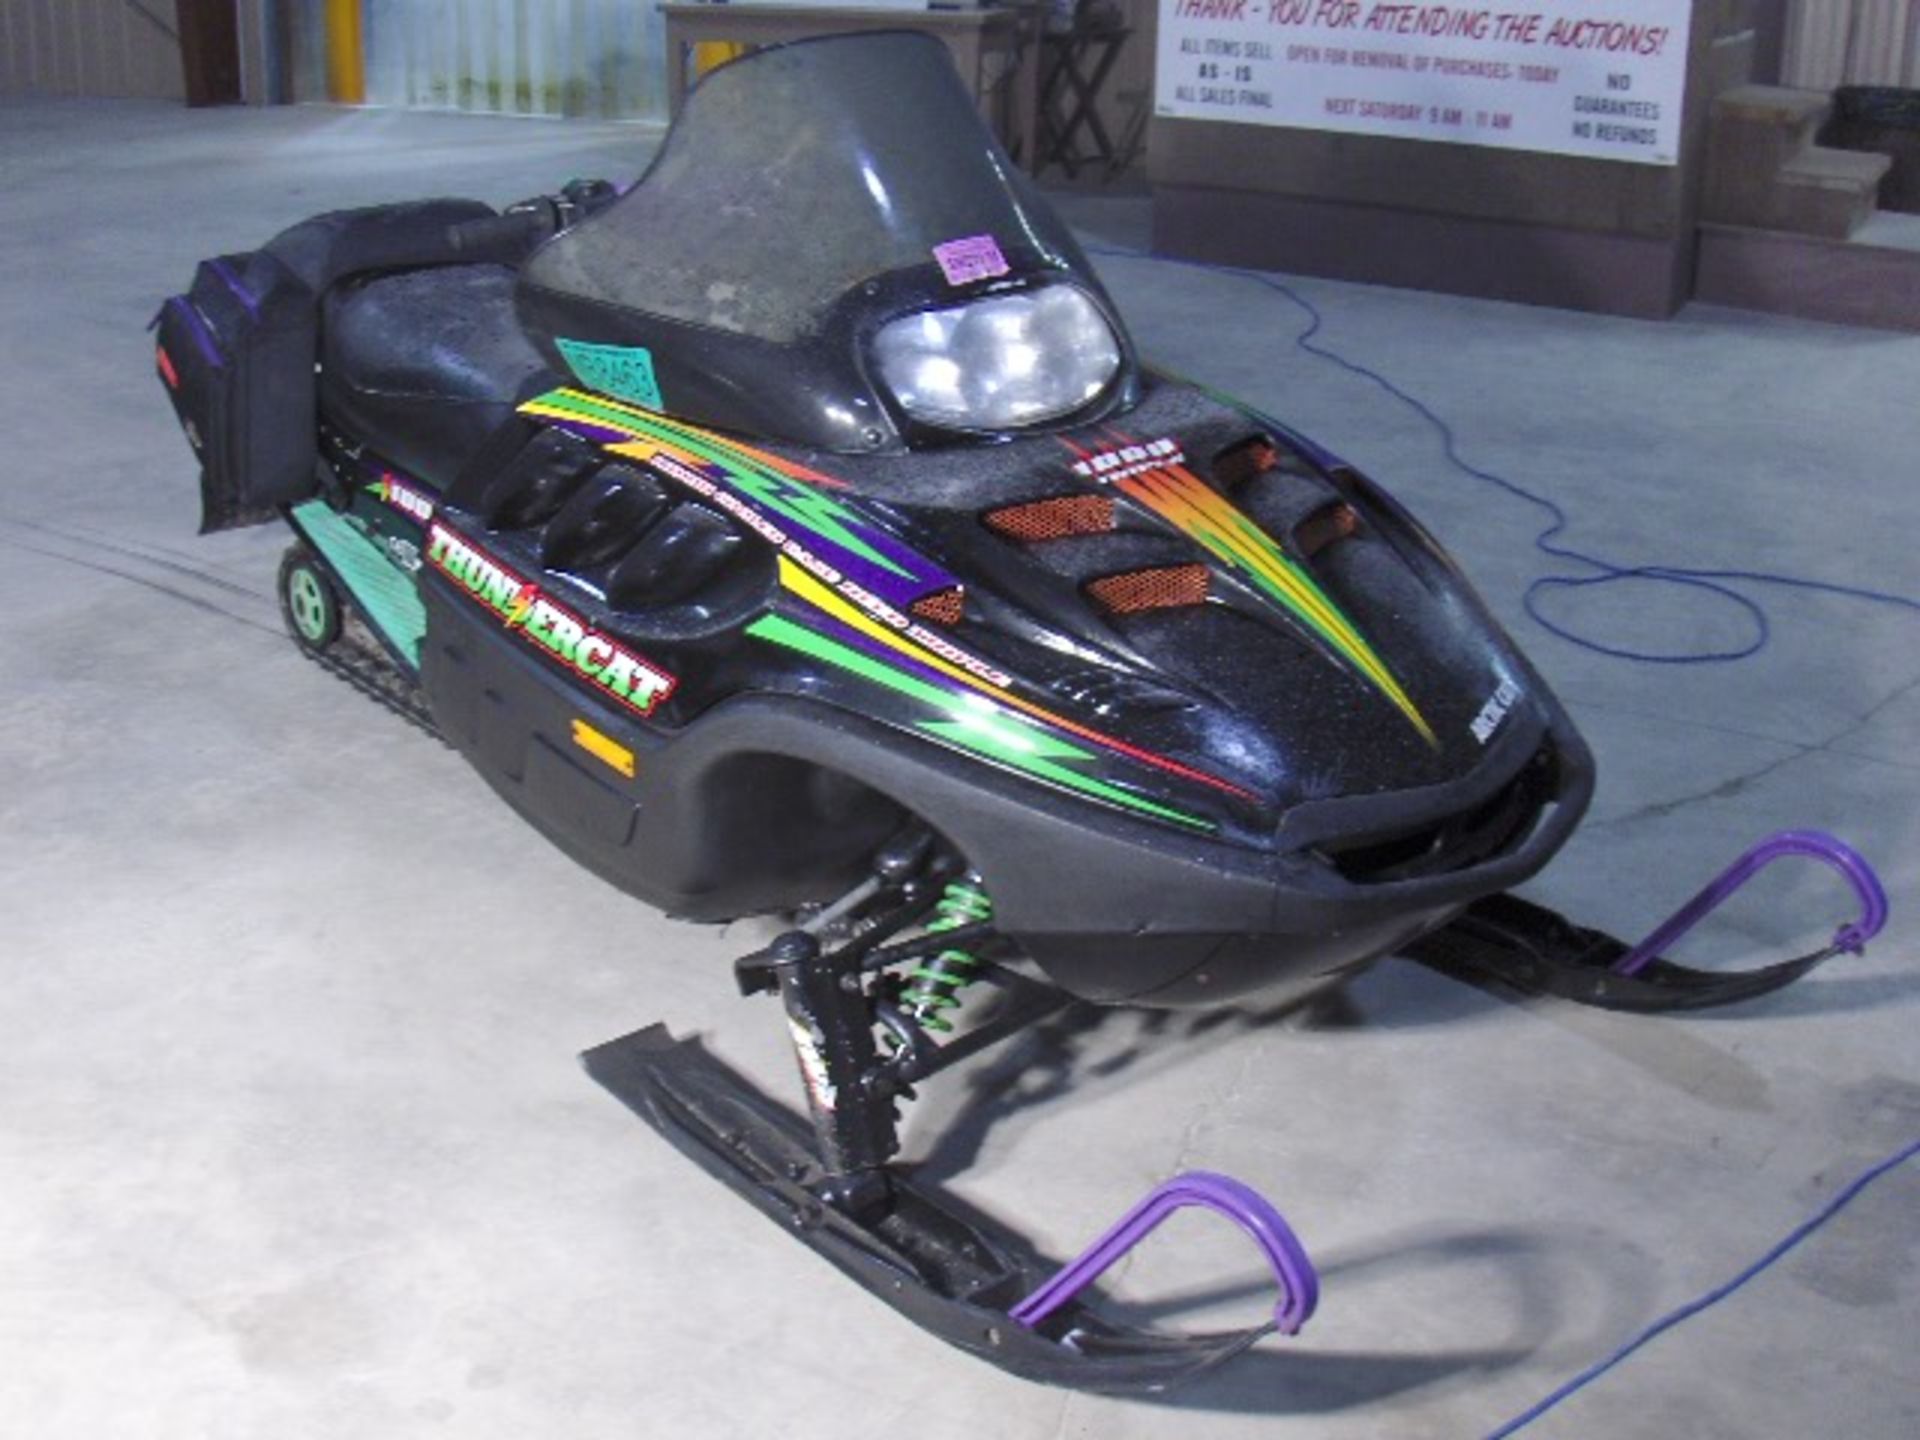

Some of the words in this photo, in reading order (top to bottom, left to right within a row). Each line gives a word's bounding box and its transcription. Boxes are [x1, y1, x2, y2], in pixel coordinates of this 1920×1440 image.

[1313, 0, 1359, 29] FOR
[1363, 4, 1489, 40] ATTENDING
[1493, 13, 1543, 43] THE
[1544, 17, 1669, 56] AUCTIONS!
[1286, 44, 1320, 63] OPEN
[1323, 47, 1347, 67] FOR
[1351, 50, 1408, 72] REMOVAL
[1518, 64, 1560, 83] TODAY
[1606, 73, 1631, 91] NO
[1325, 97, 1356, 115] NEXT
[1359, 101, 1421, 121] SATURDAY
[1573, 94, 1660, 121] GUARANTEES
[1572, 120, 1591, 139] NO
[1595, 122, 1658, 145] REFUNDS
